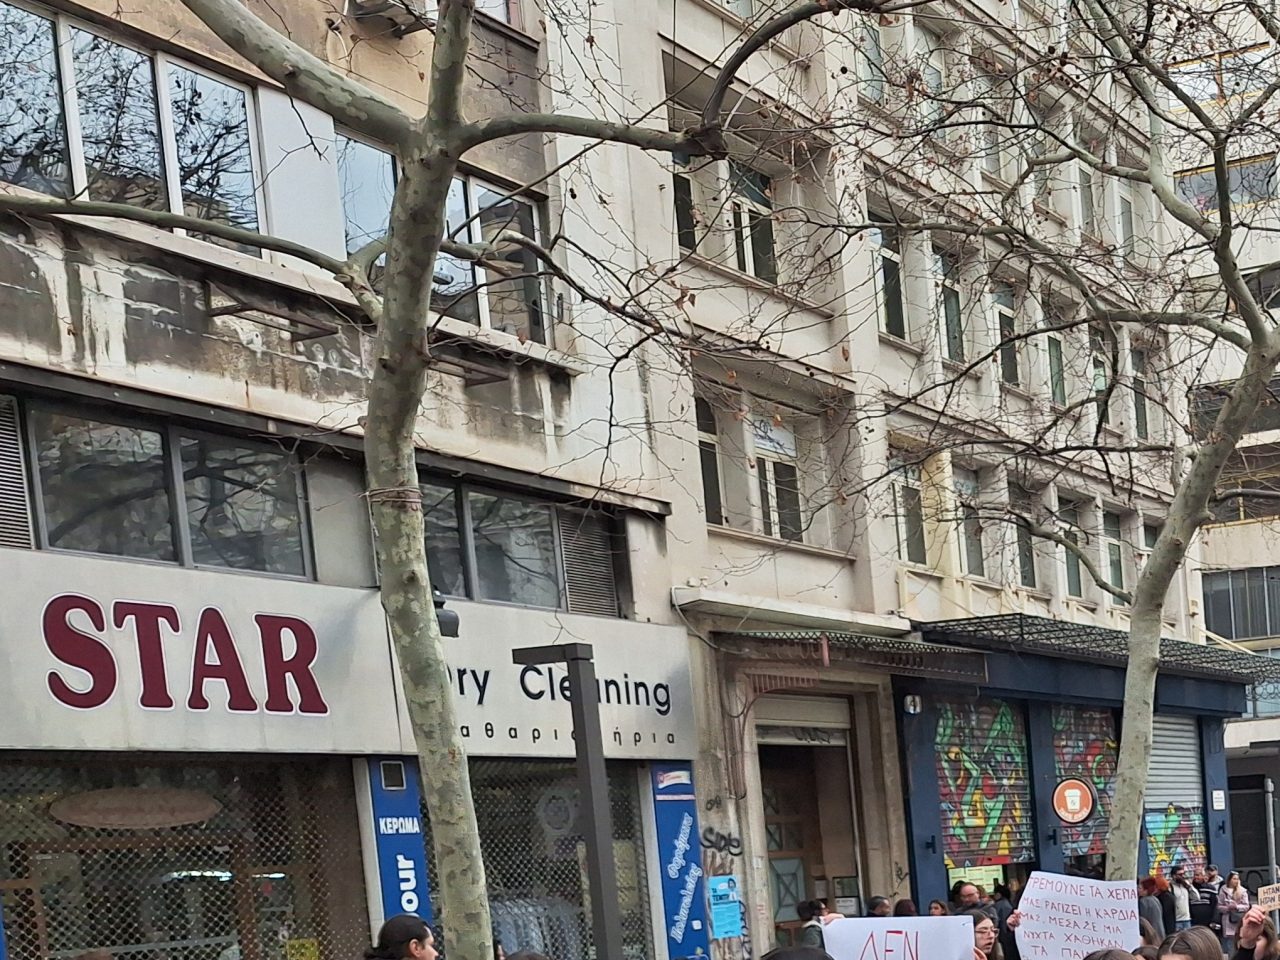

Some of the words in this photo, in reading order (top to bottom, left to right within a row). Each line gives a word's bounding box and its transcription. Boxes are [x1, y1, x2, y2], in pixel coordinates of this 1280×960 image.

[42, 592, 329, 716] STAR
[448, 665, 490, 706] ry
[460, 722, 675, 747] αθαριήρια
[379, 816, 421, 835] ΚΕΡΩΜΑ
[396, 854, 420, 918] our
[1029, 877, 1086, 896] ΤΡΕΜΟΥΝΕ
[1089, 885, 1103, 899] ΤΑ
[1023, 897, 1041, 909] ΜΑΣ
[1044, 900, 1082, 916] ΡΑΓΙΖΕΙ
[1085, 908, 1091, 916] Η
[1095, 907, 1138, 921] ΚΑΡΔΙΑ
[1048, 916, 1081, 929] ΜΕΣΑ
[1083, 921, 1098, 932] ΣΕ
[1104, 924, 1122, 934] ΜΙΑ
[1023, 930, 1056, 940] ΝΥΧΤΑ
[1064, 932, 1124, 949] ΧΑΘΗΚΑΝ
[1031, 945, 1048, 956] ΤΑ
